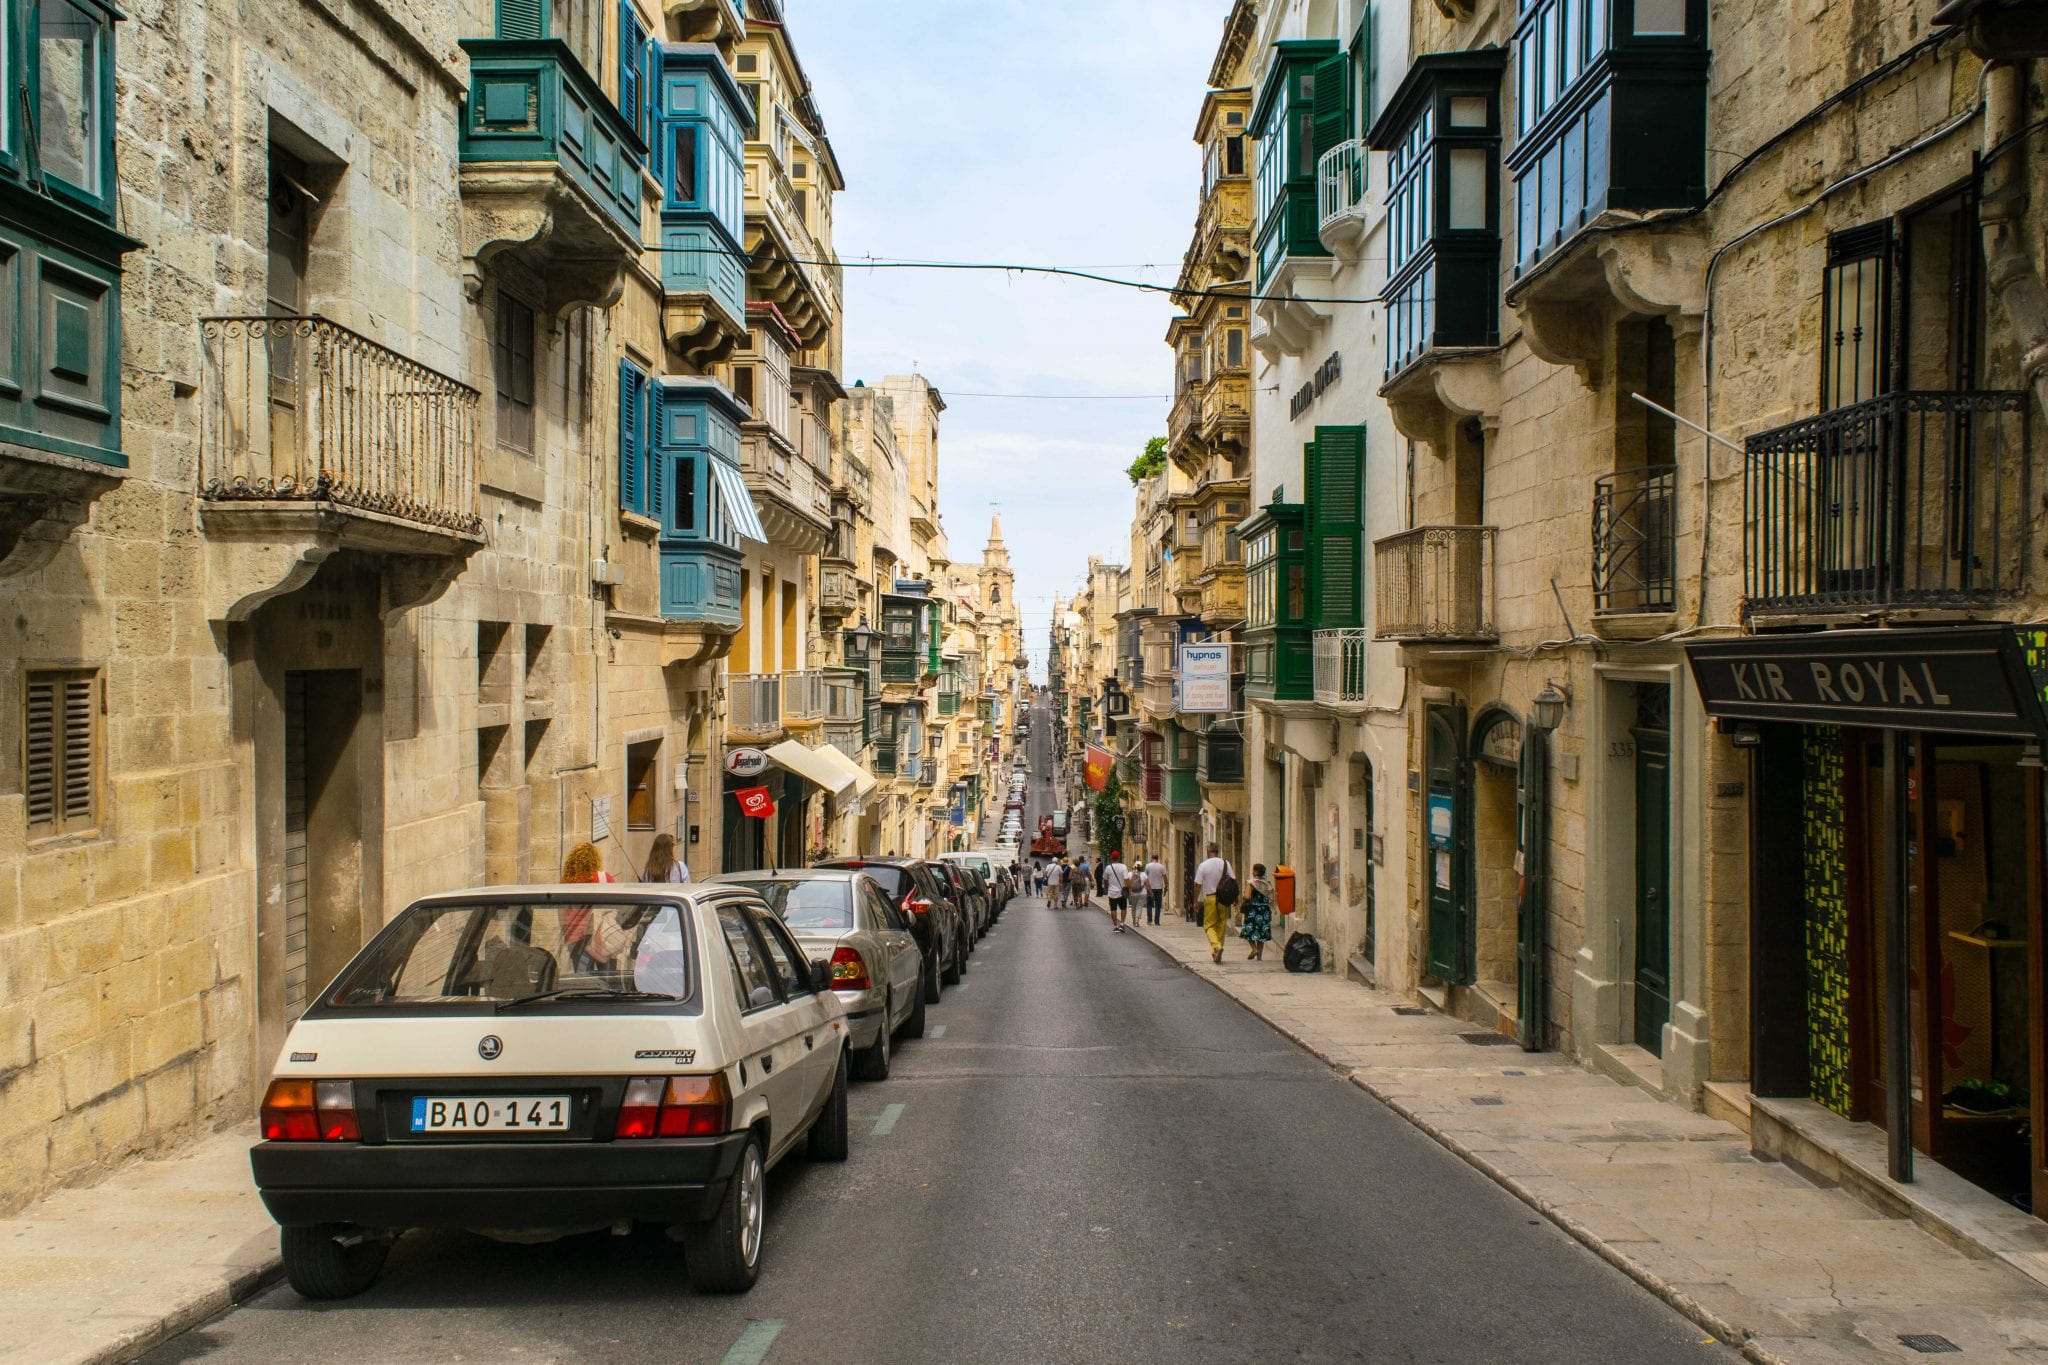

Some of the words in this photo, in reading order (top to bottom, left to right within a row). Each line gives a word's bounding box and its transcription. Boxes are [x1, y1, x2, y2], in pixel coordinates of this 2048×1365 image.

[1186, 650, 1222, 661] hypnos
[1730, 663, 1793, 701] KIR
[1810, 661, 1951, 705] ROYAL
[1608, 742, 1635, 758] 335
[430, 1101, 490, 1127] BAO
[505, 1101, 564, 1127] 141
